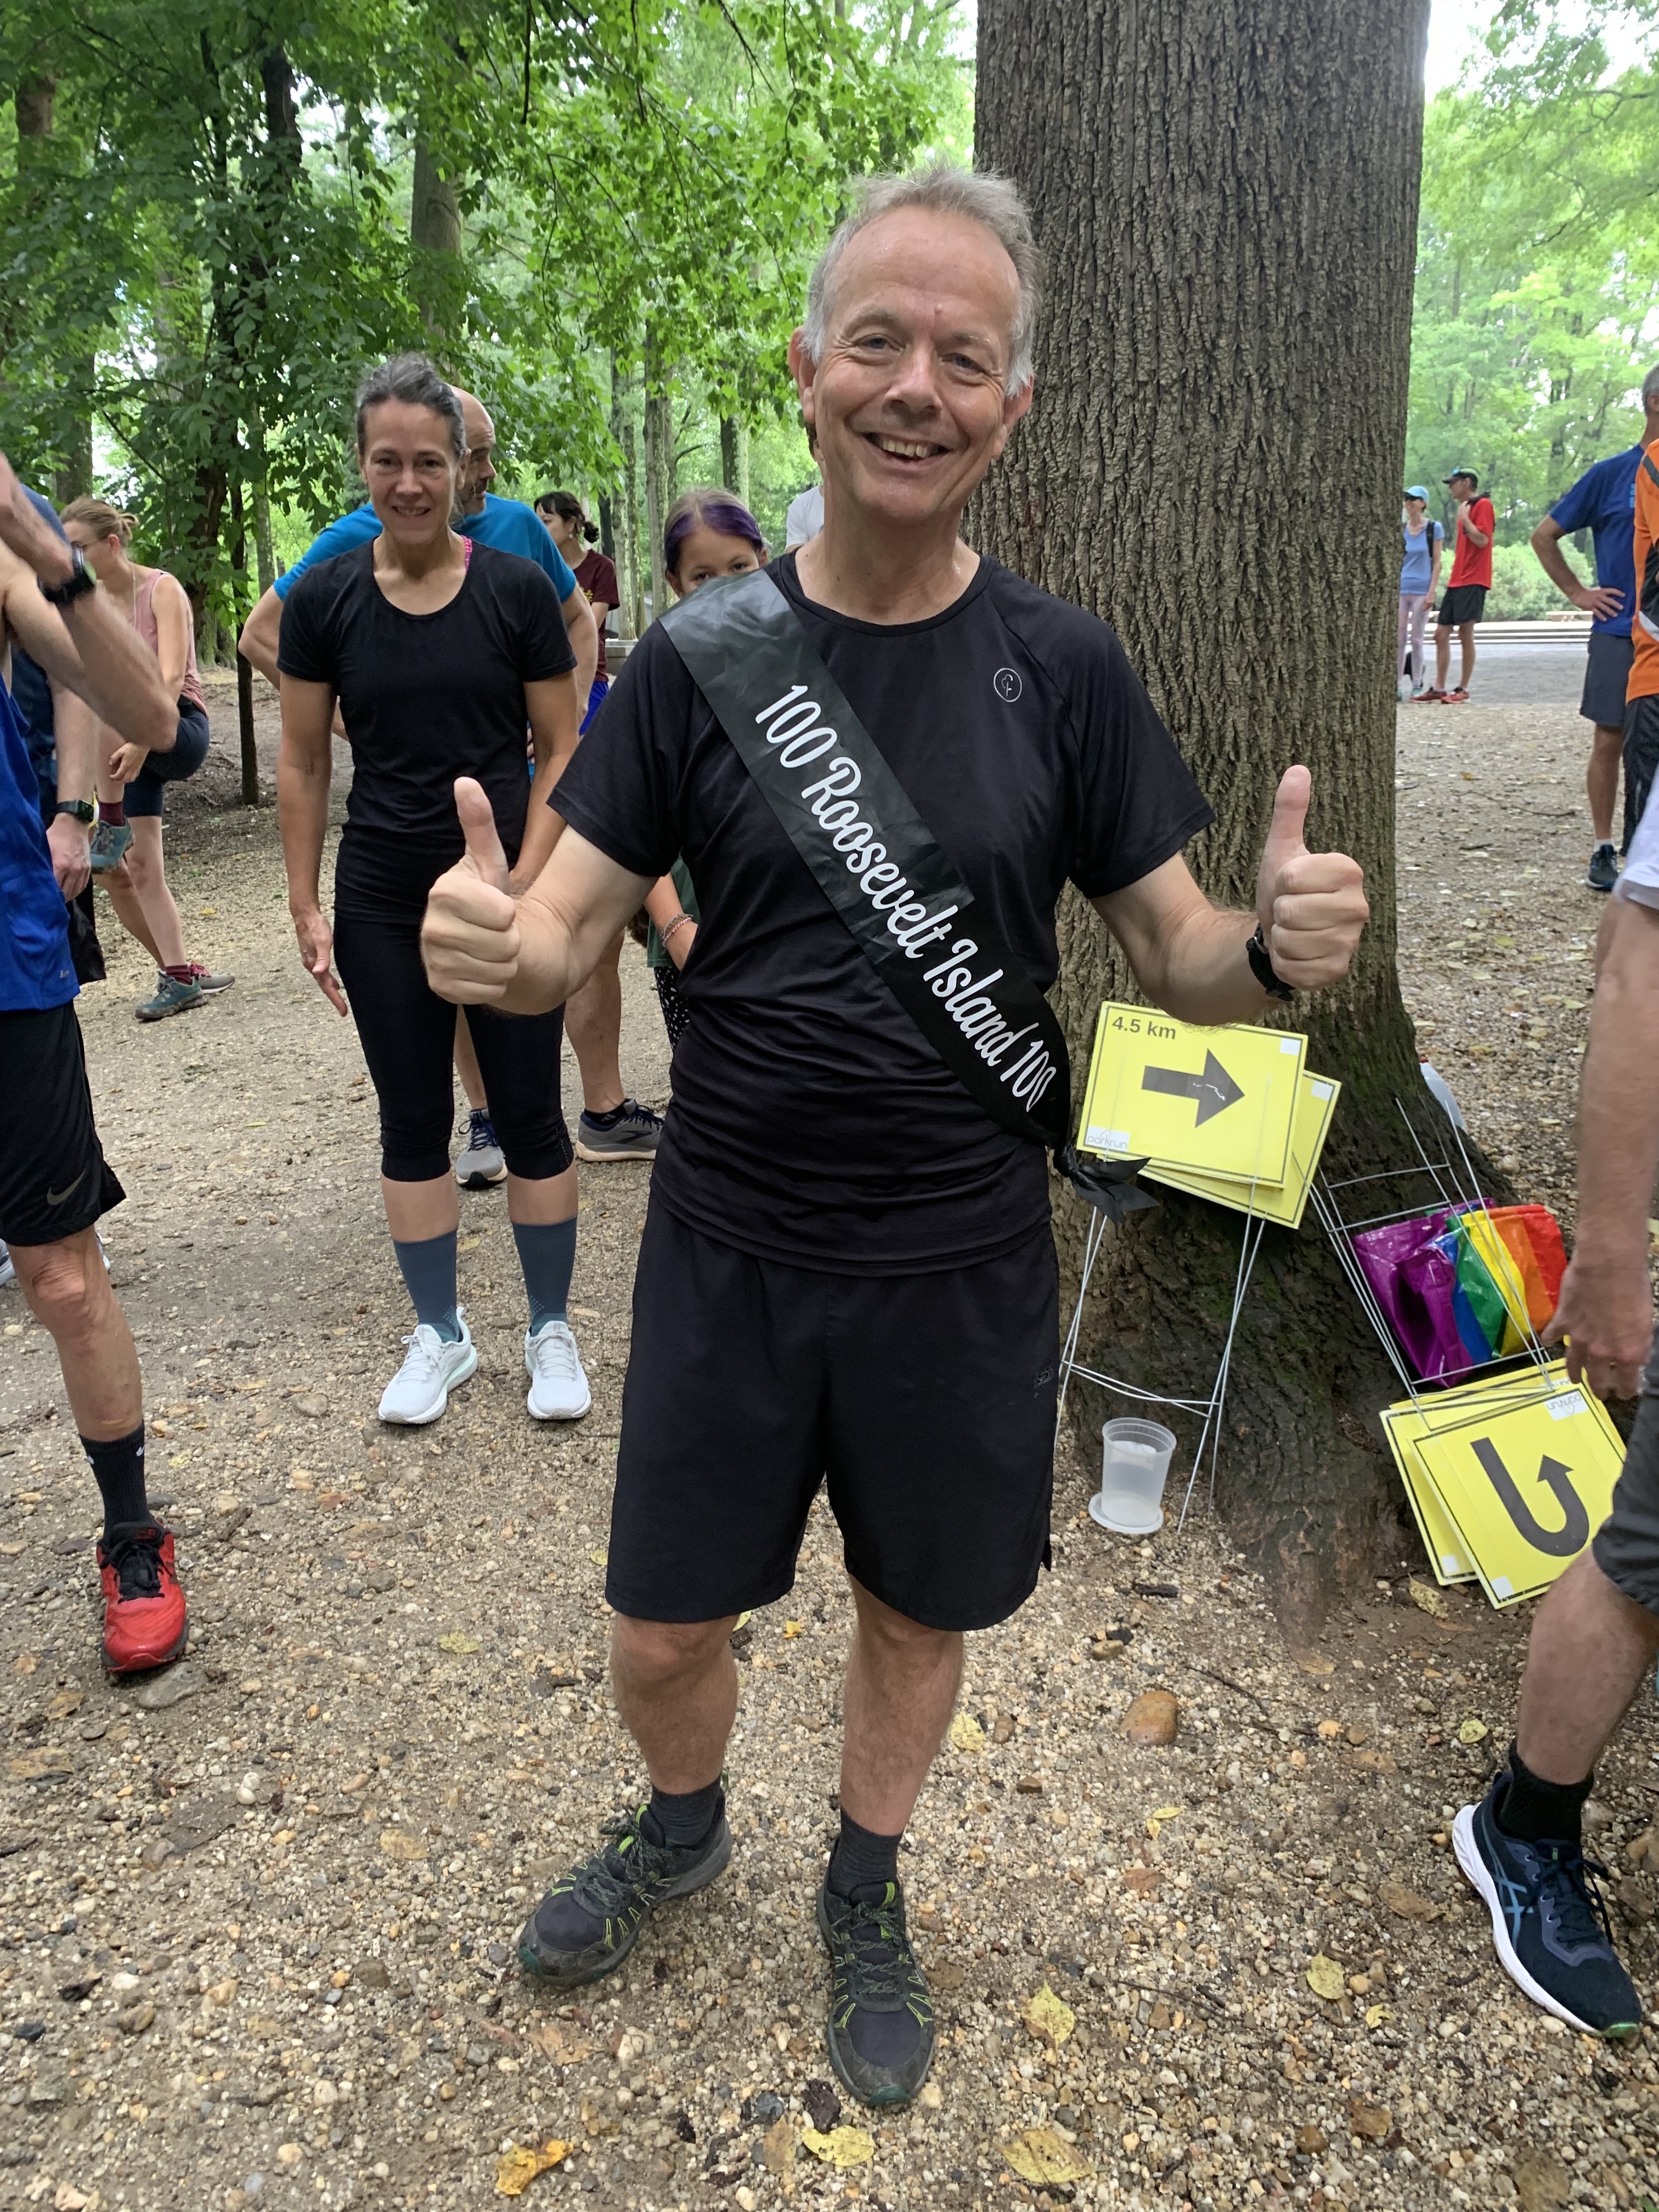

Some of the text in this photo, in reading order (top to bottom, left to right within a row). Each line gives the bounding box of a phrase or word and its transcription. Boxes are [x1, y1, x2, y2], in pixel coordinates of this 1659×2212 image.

[755, 685, 1057, 1113] 100 Roosevelt Island 100
[1112, 1016, 1176, 1040] 4.5 km
[1087, 1134, 1127, 1149] parkrun
